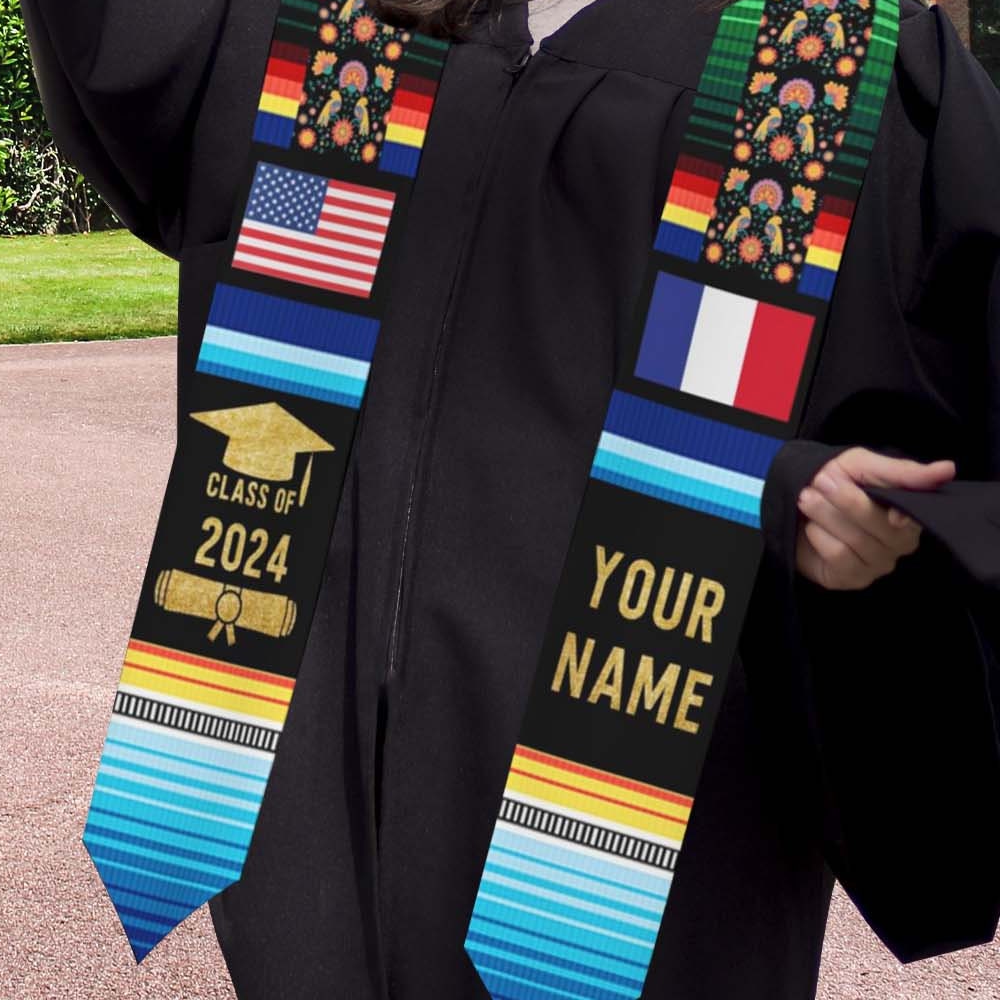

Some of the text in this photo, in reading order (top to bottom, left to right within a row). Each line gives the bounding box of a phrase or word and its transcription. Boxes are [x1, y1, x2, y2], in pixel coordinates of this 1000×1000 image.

[206, 471, 297, 515] CLASS OF
[194, 516, 291, 583] 2024
[589, 544, 726, 644] YOUR
[550, 631, 714, 734] NAME
